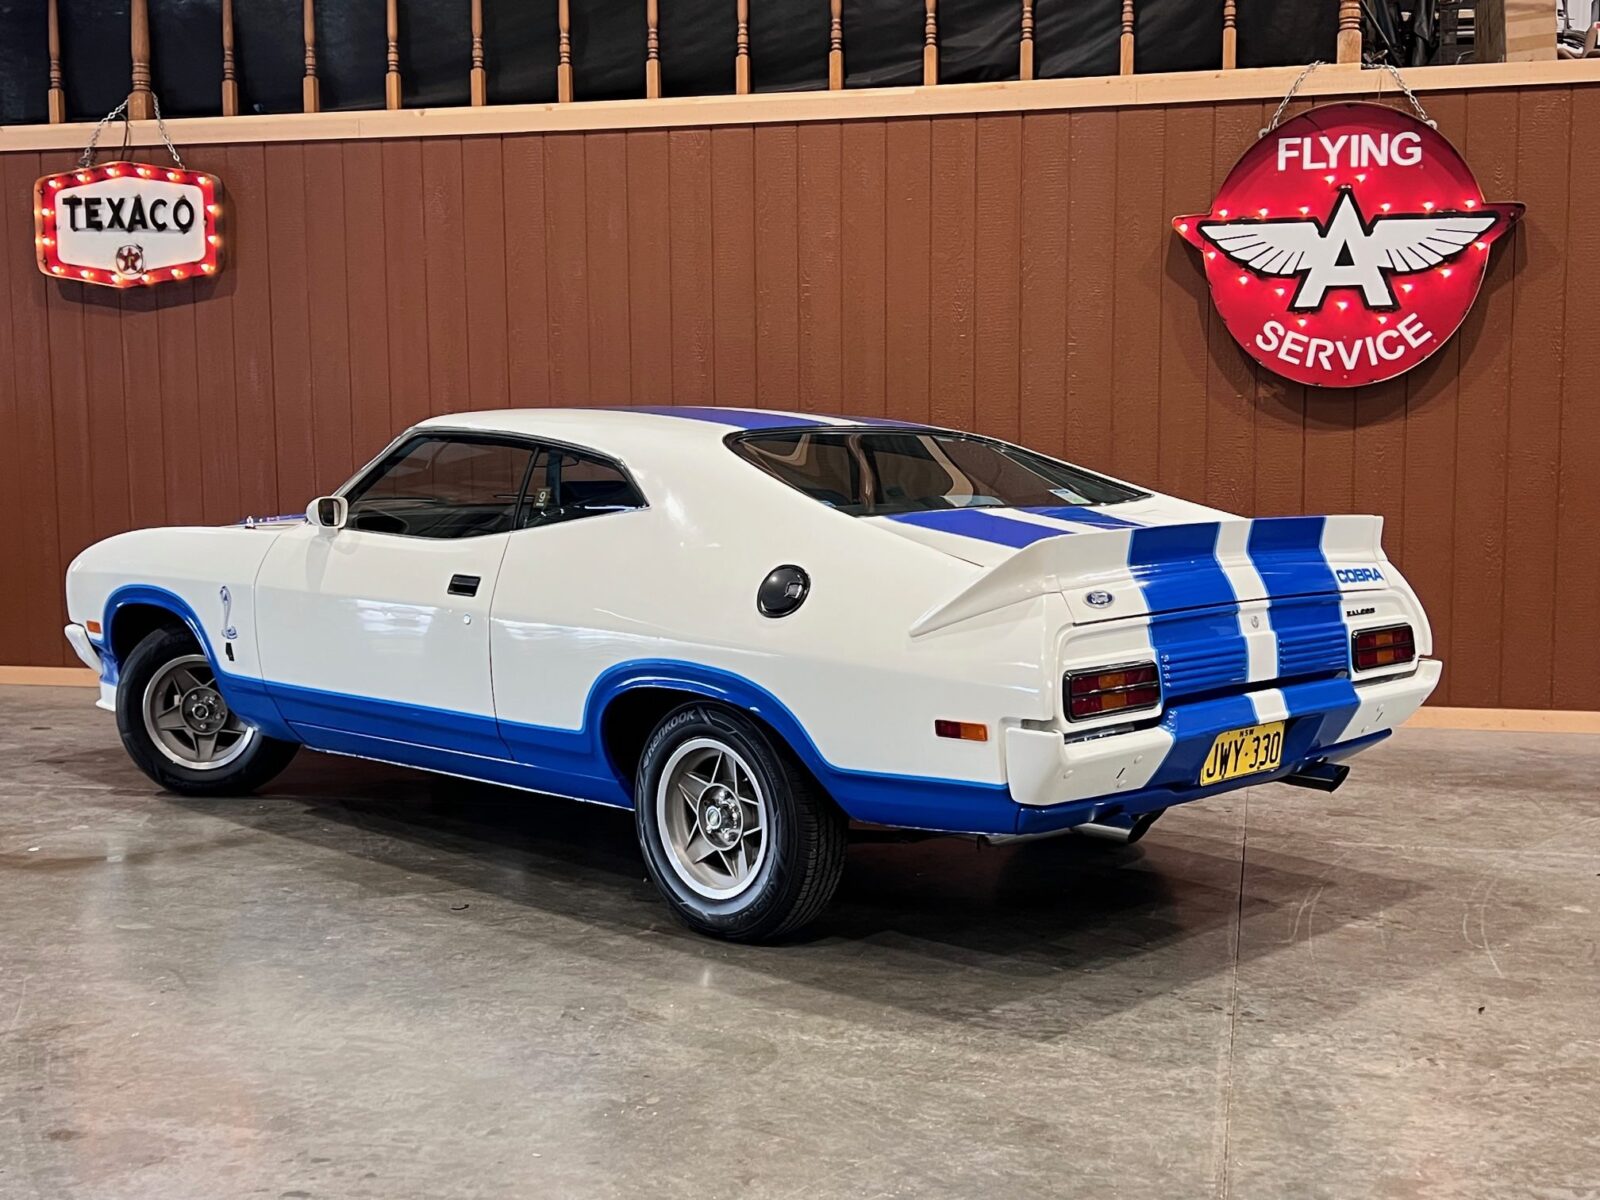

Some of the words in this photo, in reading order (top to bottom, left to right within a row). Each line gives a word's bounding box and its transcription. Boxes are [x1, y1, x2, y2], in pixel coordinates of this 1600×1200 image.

[1277, 131, 1422, 171] FLYING
[62, 195, 195, 233] TEXACO
[1255, 312, 1432, 370] SERVICE
[1336, 567, 1384, 583] COBRA
[1239, 729, 1255, 738] NSW
